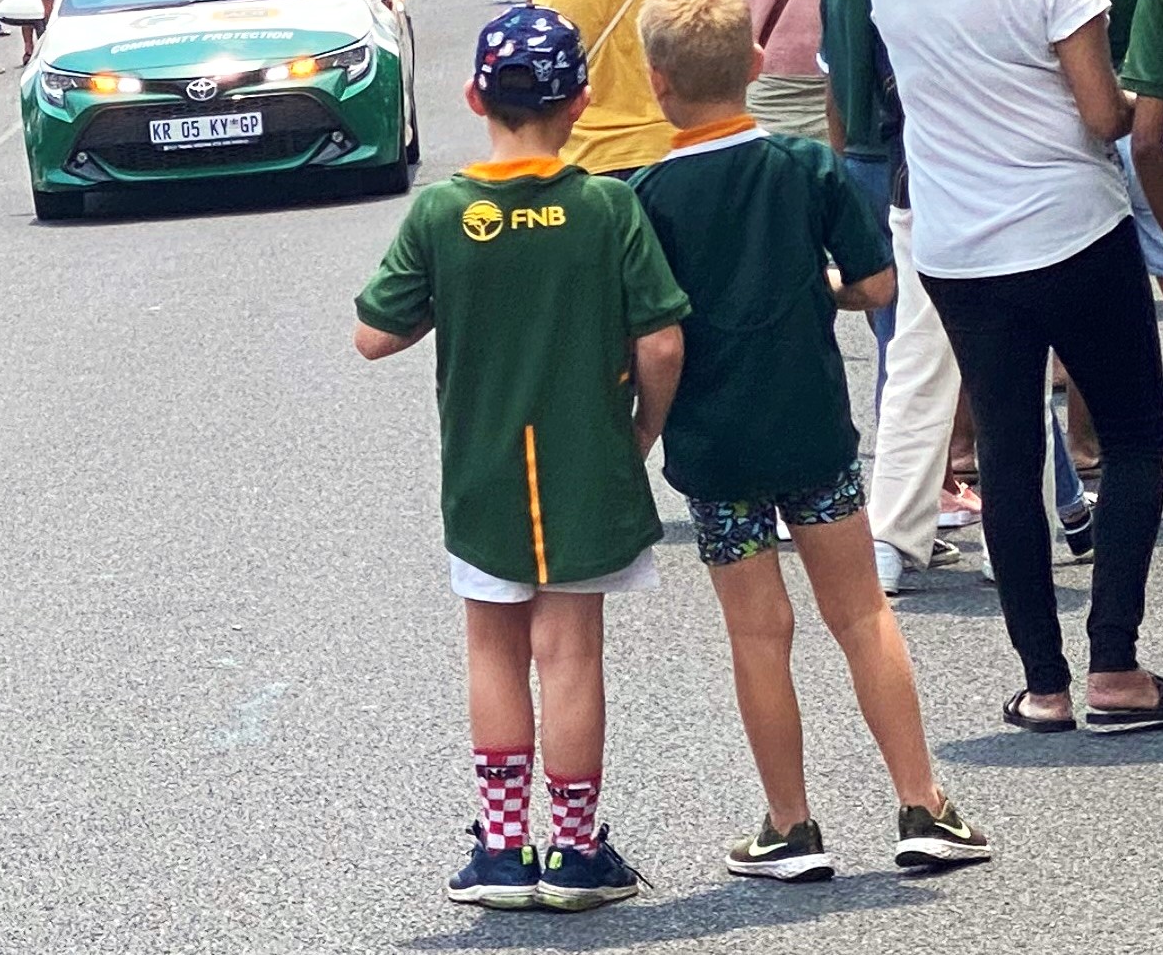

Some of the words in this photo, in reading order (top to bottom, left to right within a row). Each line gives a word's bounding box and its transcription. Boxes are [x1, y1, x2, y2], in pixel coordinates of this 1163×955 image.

[110, 34, 200, 54] COMMUNITY
[201, 31, 294, 42] PROTECTION
[152, 121, 172, 141] KR
[181, 120, 200, 139] 05
[210, 115, 229, 136] KY
[240, 114, 259, 133] GP
[511, 206, 566, 230] FNB
